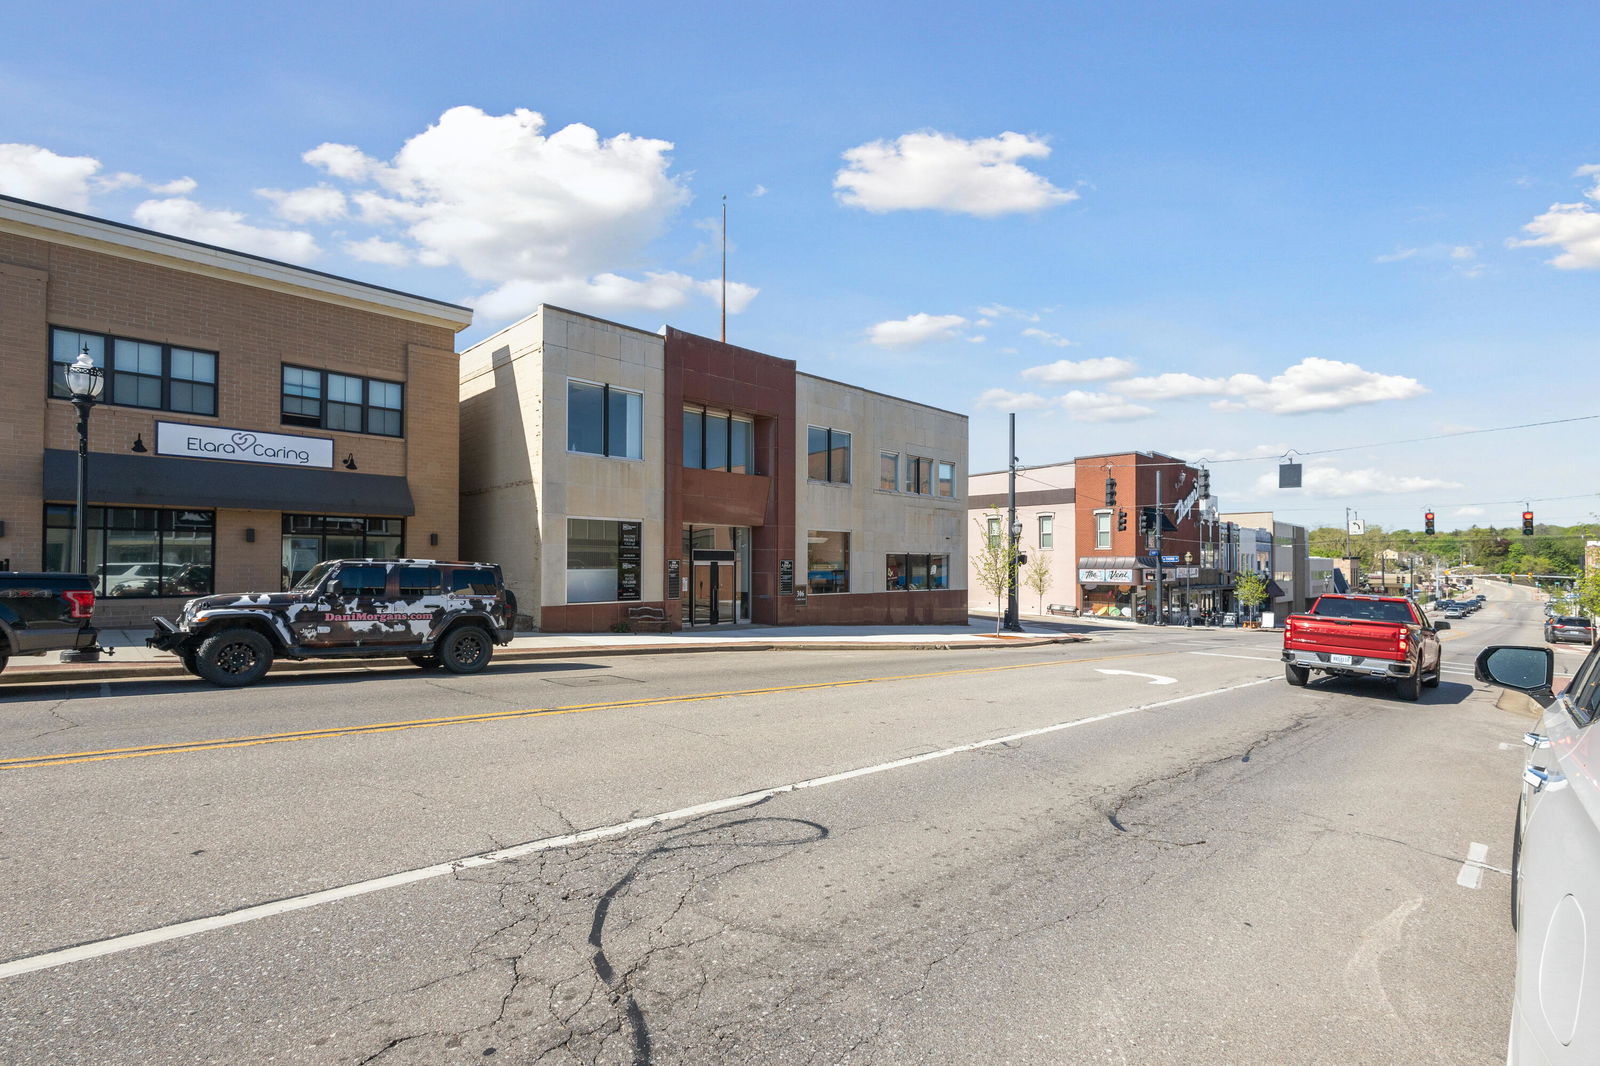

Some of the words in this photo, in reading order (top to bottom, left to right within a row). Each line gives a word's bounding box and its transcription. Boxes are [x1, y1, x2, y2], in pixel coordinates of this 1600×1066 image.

[187, 436, 236, 454] Elara
[253, 443, 310, 464] Caring
[1085, 570, 1097, 579] The
[324, 612, 434, 622] DaniMorgans.com
